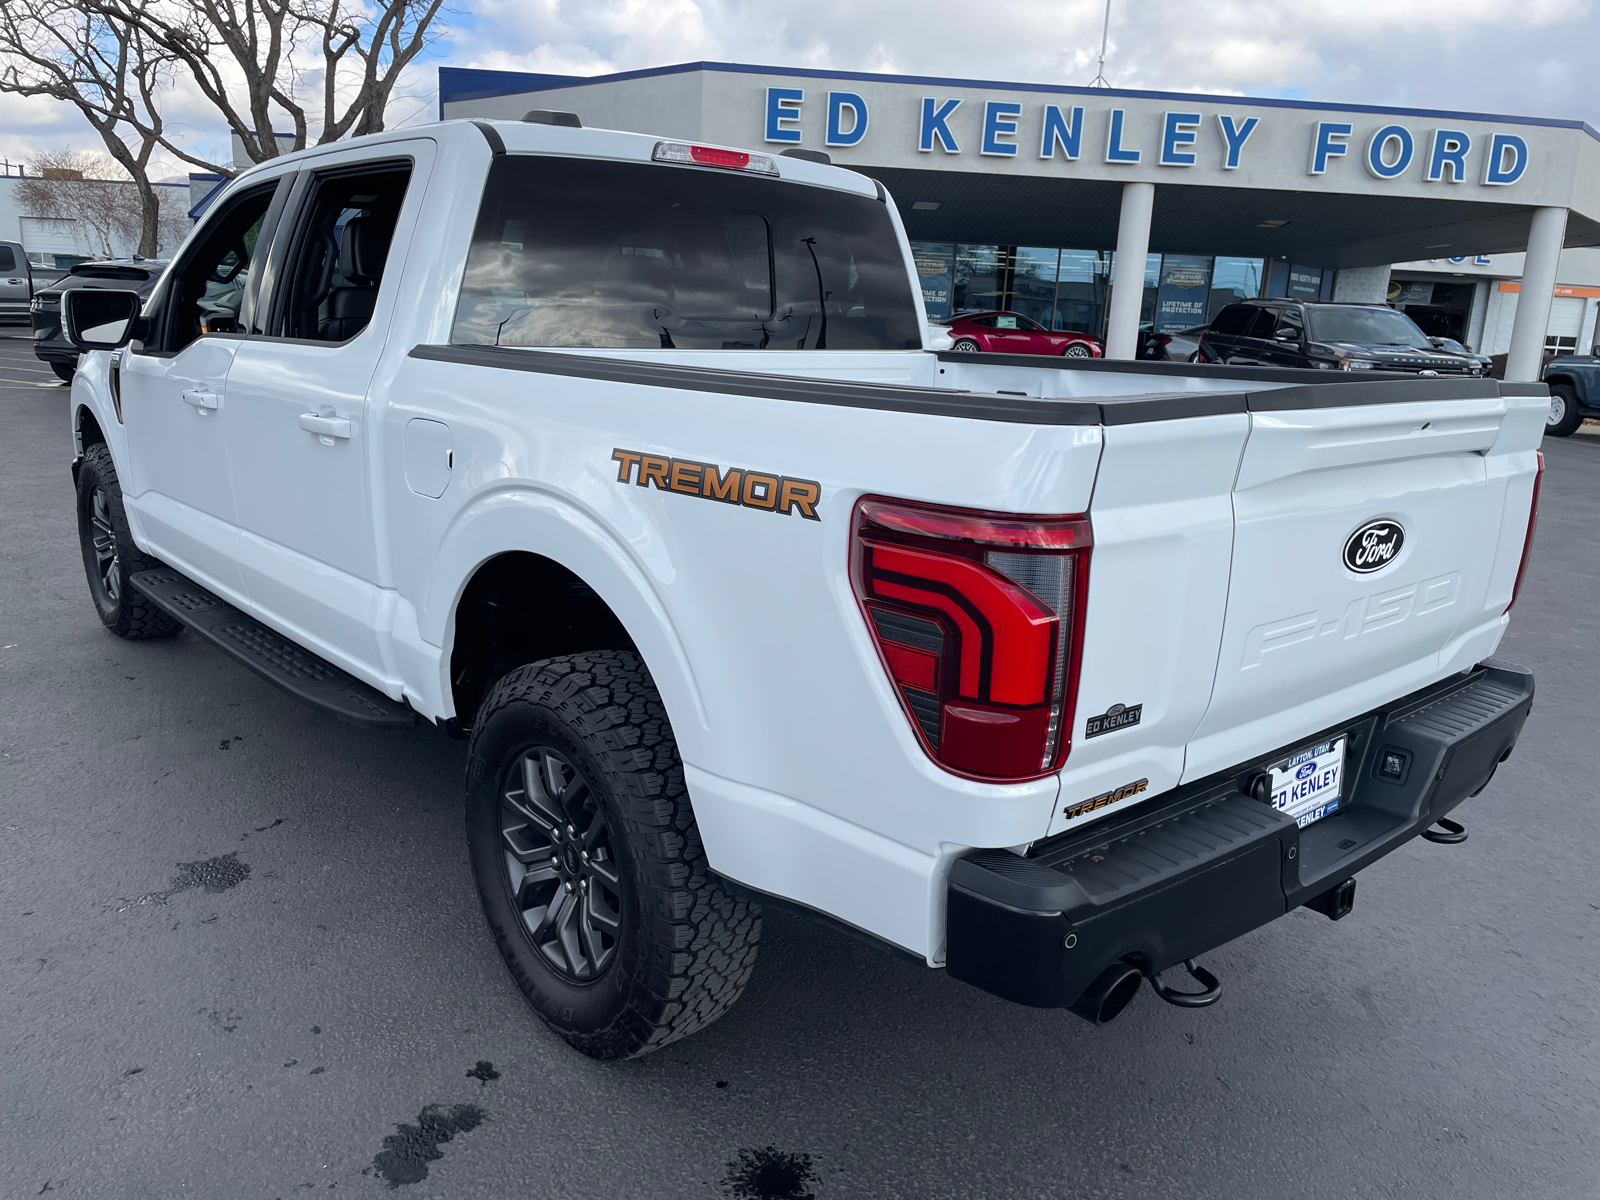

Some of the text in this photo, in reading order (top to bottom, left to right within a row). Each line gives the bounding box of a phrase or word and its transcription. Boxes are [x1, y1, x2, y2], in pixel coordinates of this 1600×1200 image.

[764, 86, 1529, 186] ED KENLEY FORD
[1161, 306, 1203, 315] PROTECTION
[1162, 300, 1193, 308] LIFETIME
[1393, 357, 1460, 366] EXPEDITION
[611, 447, 822, 523] TREMOR
[1355, 527, 1398, 566] Ford
[1240, 570, 1462, 671] F-150
[1086, 708, 1142, 734] ED KENLEY
[1314, 742, 1331, 757] UTAH
[1063, 777, 1149, 820] TREMOR
[1271, 790, 1287, 809] ED
[1291, 766, 1339, 802] KENLEY
[1296, 805, 1326, 828] KENLEY
